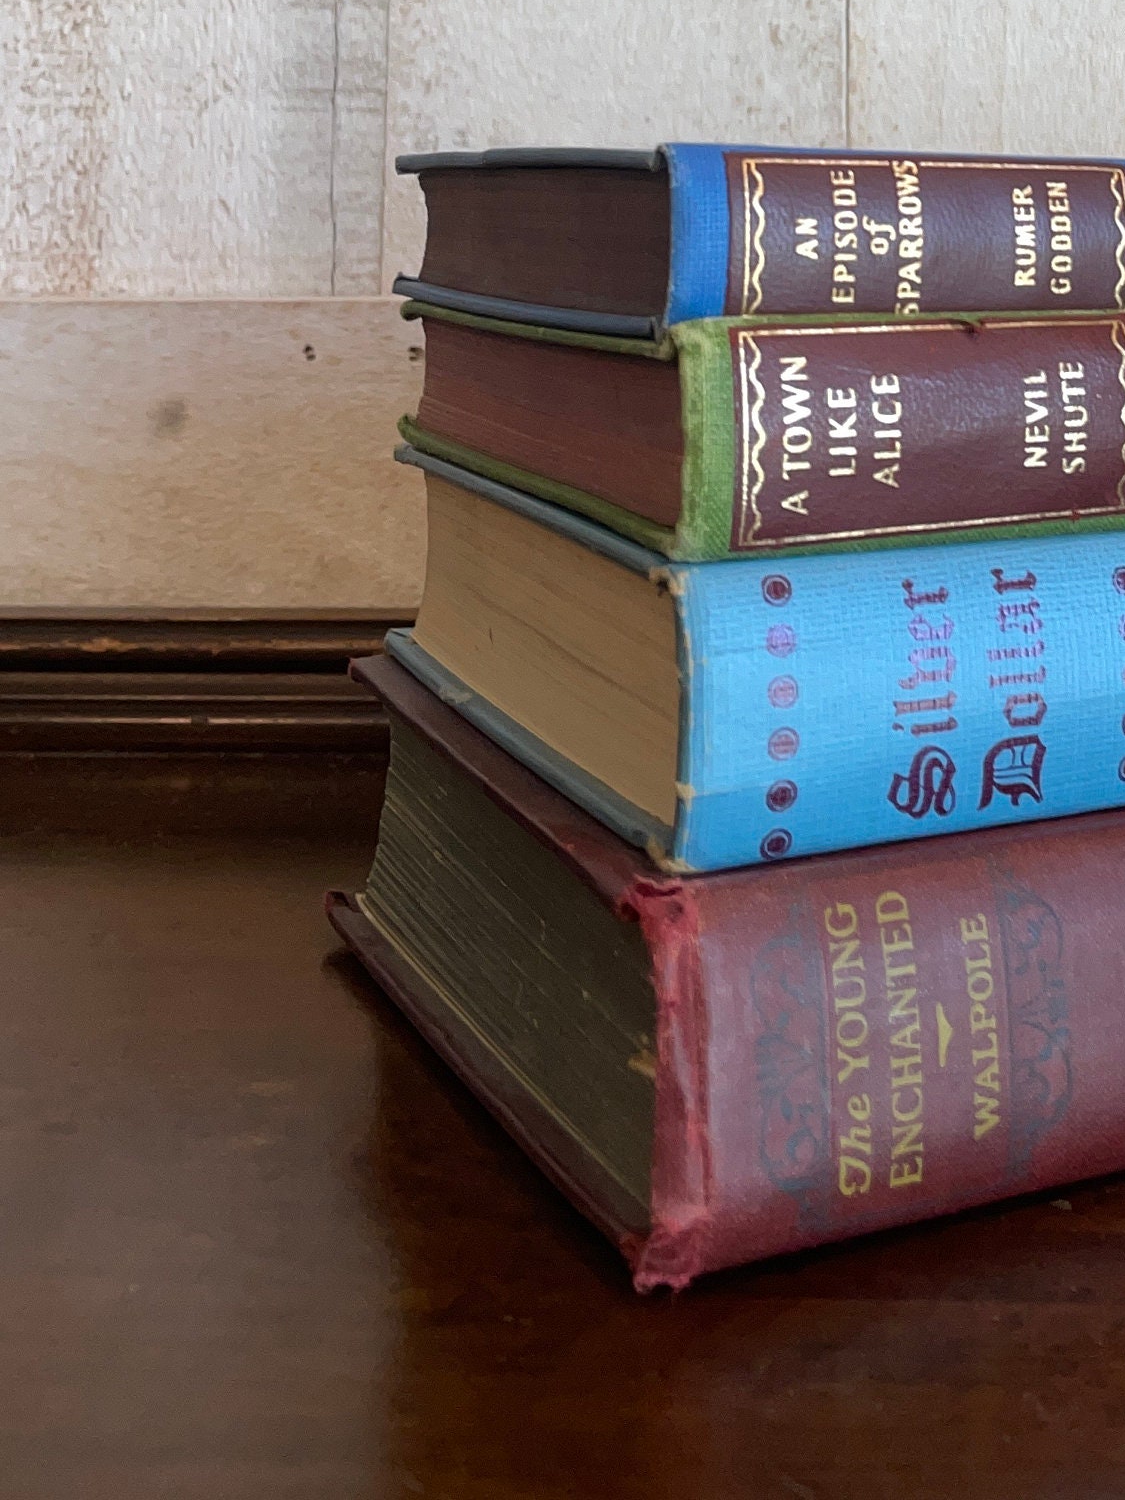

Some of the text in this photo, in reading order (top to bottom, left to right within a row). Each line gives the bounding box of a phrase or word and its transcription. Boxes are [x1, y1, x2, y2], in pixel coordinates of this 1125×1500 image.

[795, 216, 819, 260] AN
[829, 169, 857, 304] EPISODE
[863, 215, 897, 256] of
[892, 159, 924, 316] SPARROWS
[1013, 184, 1037, 287] RUMER
[1049, 181, 1073, 295] GODDEN
[779, 356, 813, 515] A TOWN
[828, 386, 858, 476] LIKE
[870, 373, 902, 488] ALICE
[1023, 369, 1048, 468] NEVIL
[1058, 361, 1088, 474] SHUTE
[887, 579, 957, 818] Silver
[978, 568, 1047, 810] Dollar
[824, 902, 873, 1197] The YOUNG
[876, 890, 923, 1189] ENCHANTED
[960, 912, 1001, 1141] WALPOLE
